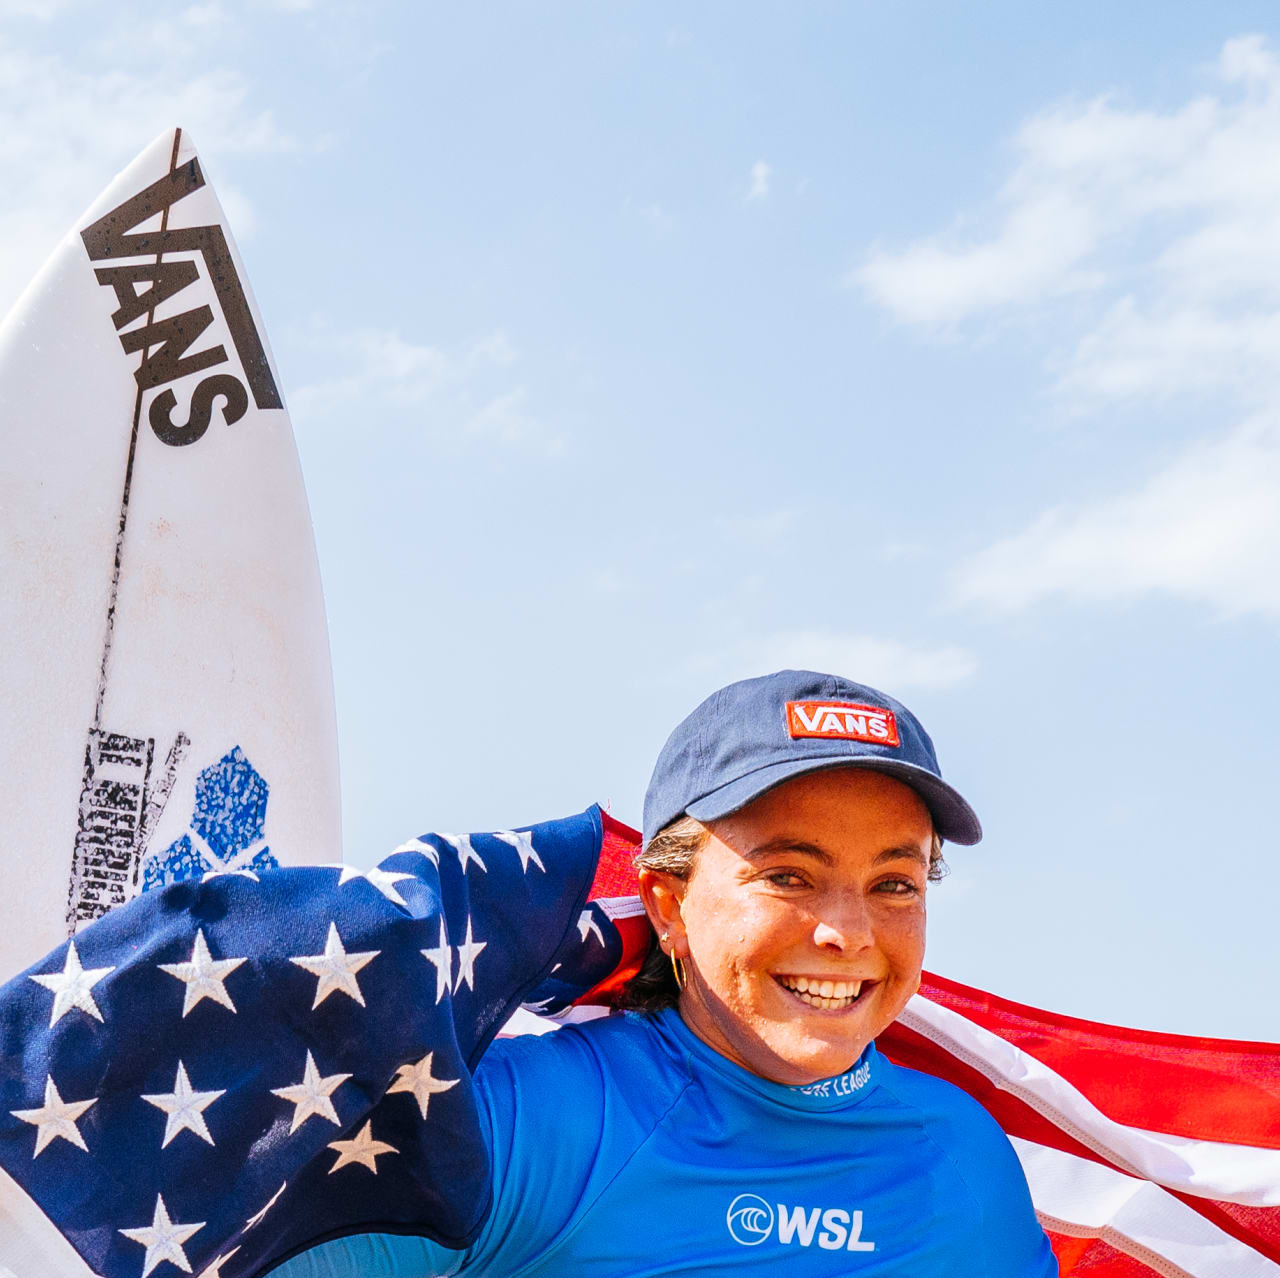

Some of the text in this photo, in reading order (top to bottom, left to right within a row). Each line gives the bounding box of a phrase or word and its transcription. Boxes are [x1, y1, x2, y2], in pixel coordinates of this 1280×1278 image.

[80, 156, 284, 447] VANS
[794, 706, 889, 738] VANS
[833, 1061, 872, 1097] LEAGUE
[776, 1203, 875, 1252] WSL
